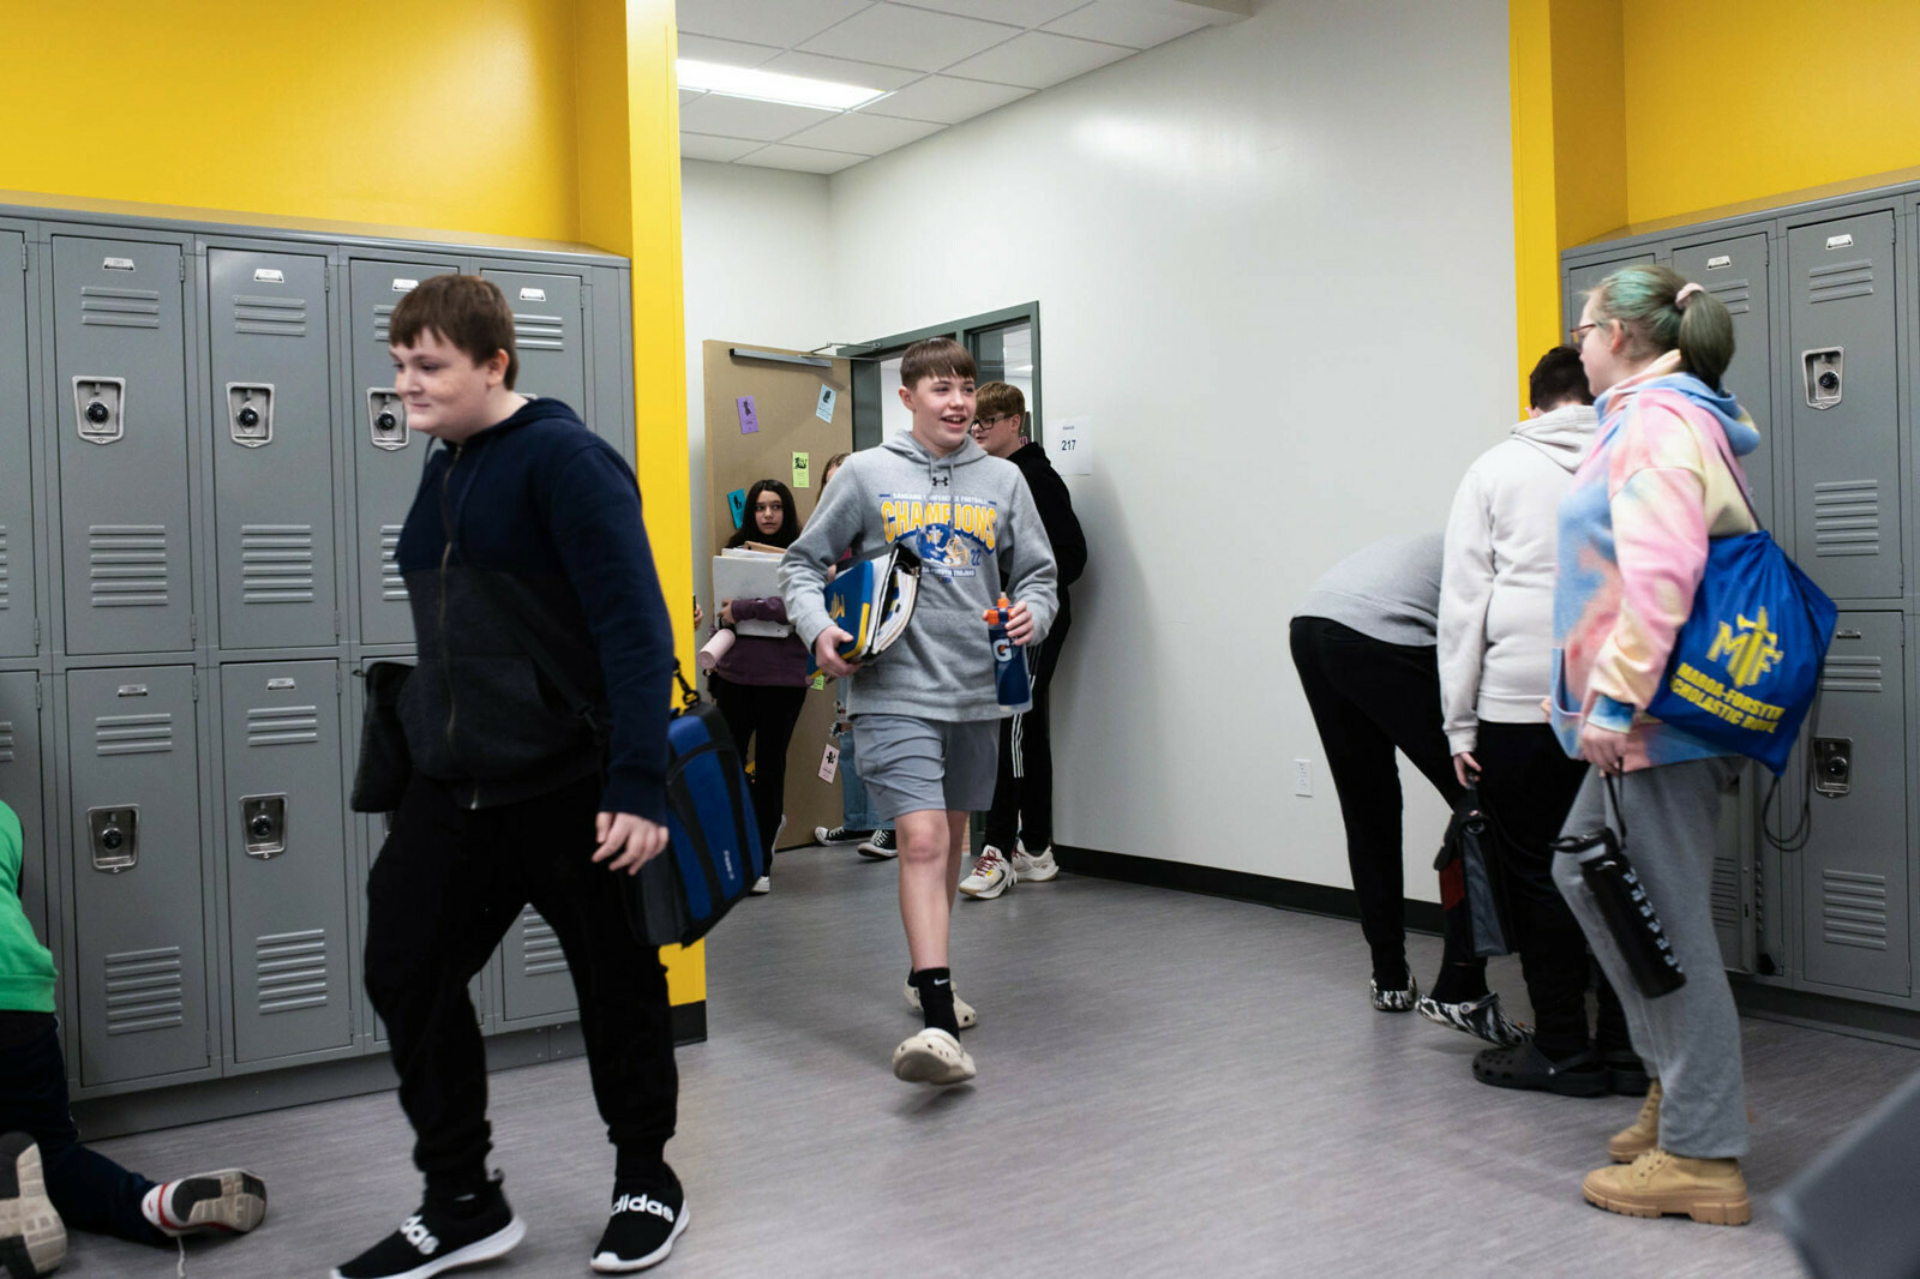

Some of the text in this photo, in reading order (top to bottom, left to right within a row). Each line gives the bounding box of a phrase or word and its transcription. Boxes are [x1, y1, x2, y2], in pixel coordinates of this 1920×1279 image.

[1061, 439, 1076, 451] 217
[993, 638, 1012, 661] G
[611, 1193, 674, 1223] didas
